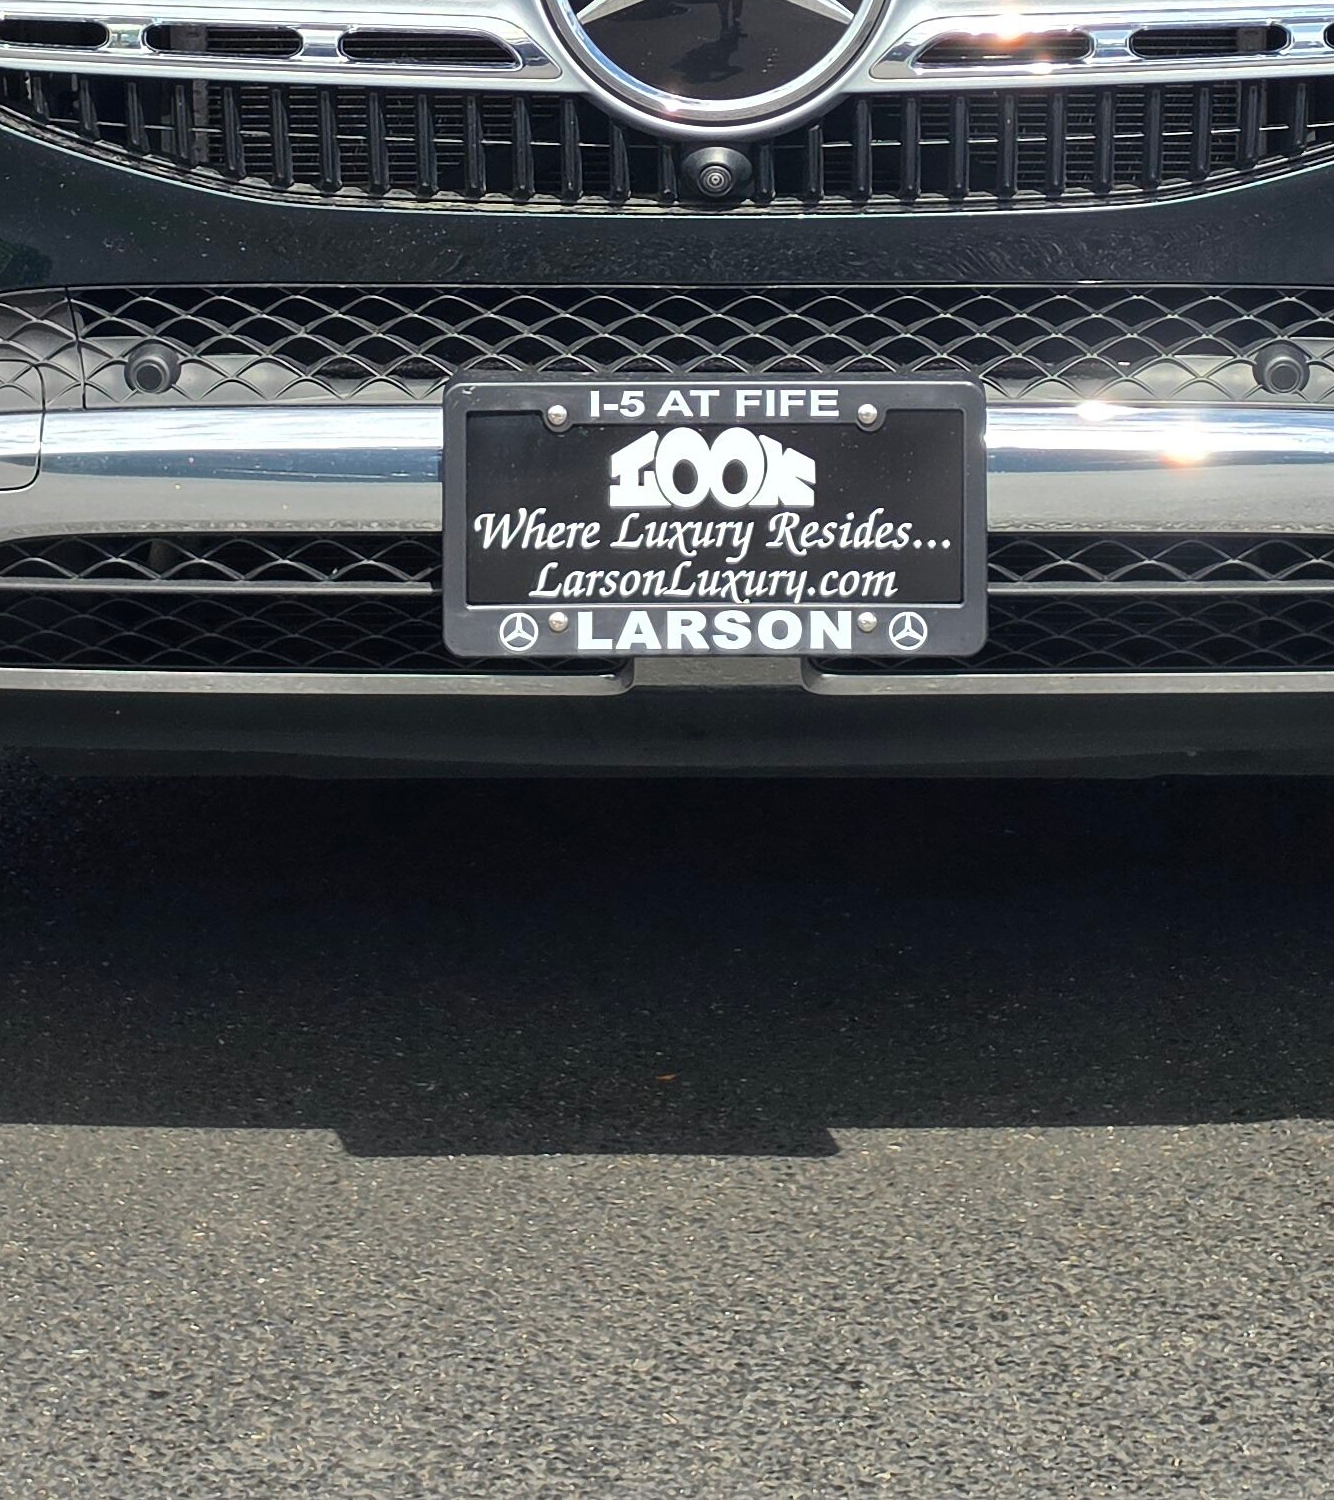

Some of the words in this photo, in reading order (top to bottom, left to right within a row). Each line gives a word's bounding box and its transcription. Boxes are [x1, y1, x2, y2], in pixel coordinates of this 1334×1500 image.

[589, 390, 646, 418] I-5
[656, 389, 721, 418] AT
[735, 389, 840, 418] FIFE
[473, 507, 601, 550] Where
[610, 512, 755, 565] Luxury
[765, 507, 952, 557] Resides...
[528, 560, 899, 606] LarsonLuxury.com
[575, 610, 853, 652] LARSON
